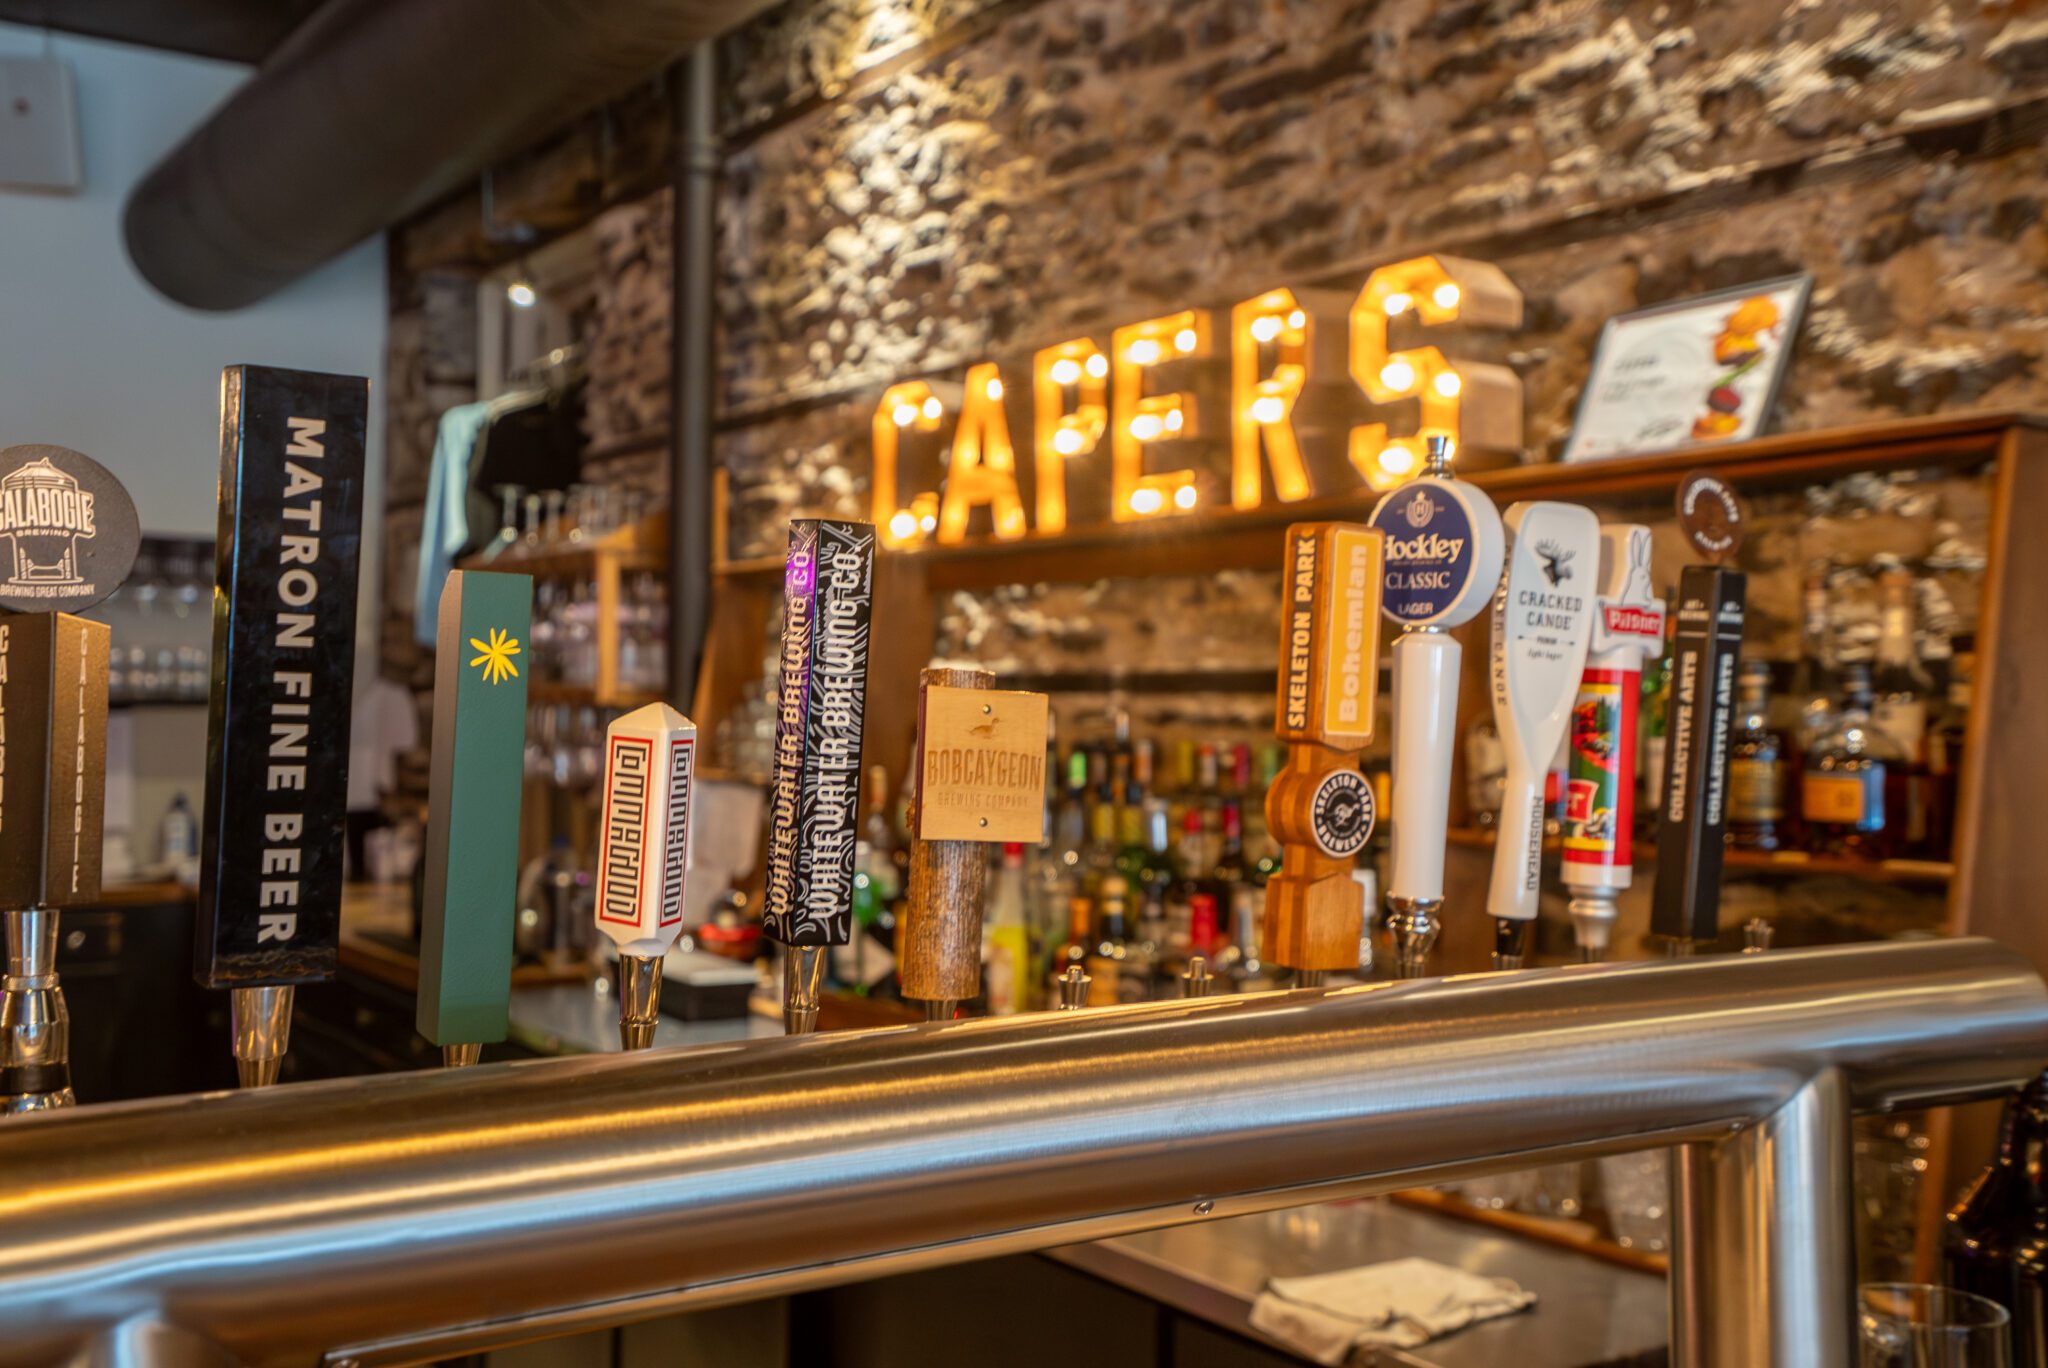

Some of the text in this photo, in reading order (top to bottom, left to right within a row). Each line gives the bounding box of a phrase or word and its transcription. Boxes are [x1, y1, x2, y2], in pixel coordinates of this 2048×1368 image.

[872, 255, 1462, 550] CAPERS
[0, 488, 95, 533] ALABOGIE
[16, 529, 70, 537] BREWING
[36, 587, 58, 598] GREAT
[1385, 572, 1450, 589] CLASSIC
[1519, 590, 1583, 612] CRACKED
[1398, 602, 1433, 614] LAGER
[1527, 611, 1572, 630] CANOE
[1287, 539, 1316, 728] SKELETON PARK
[1338, 544, 1368, 723] Bohemian
[257, 416, 326, 944] MATRON FINE BEER
[783, 597, 807, 725] BREWING
[822, 600, 858, 727] BREWING
[72, 627, 89, 893] CALABOGIE
[927, 748, 1042, 792] BOBCAYGEON
[937, 791, 982, 808] BREWING
[1316, 774, 1358, 815] SKELETON
[771, 733, 798, 916] WHITEWATER
[808, 737, 849, 920] WHITEWATER
[1318, 824, 1363, 851] BREWERY
[1527, 796, 1544, 890] MOOSEHEAD
